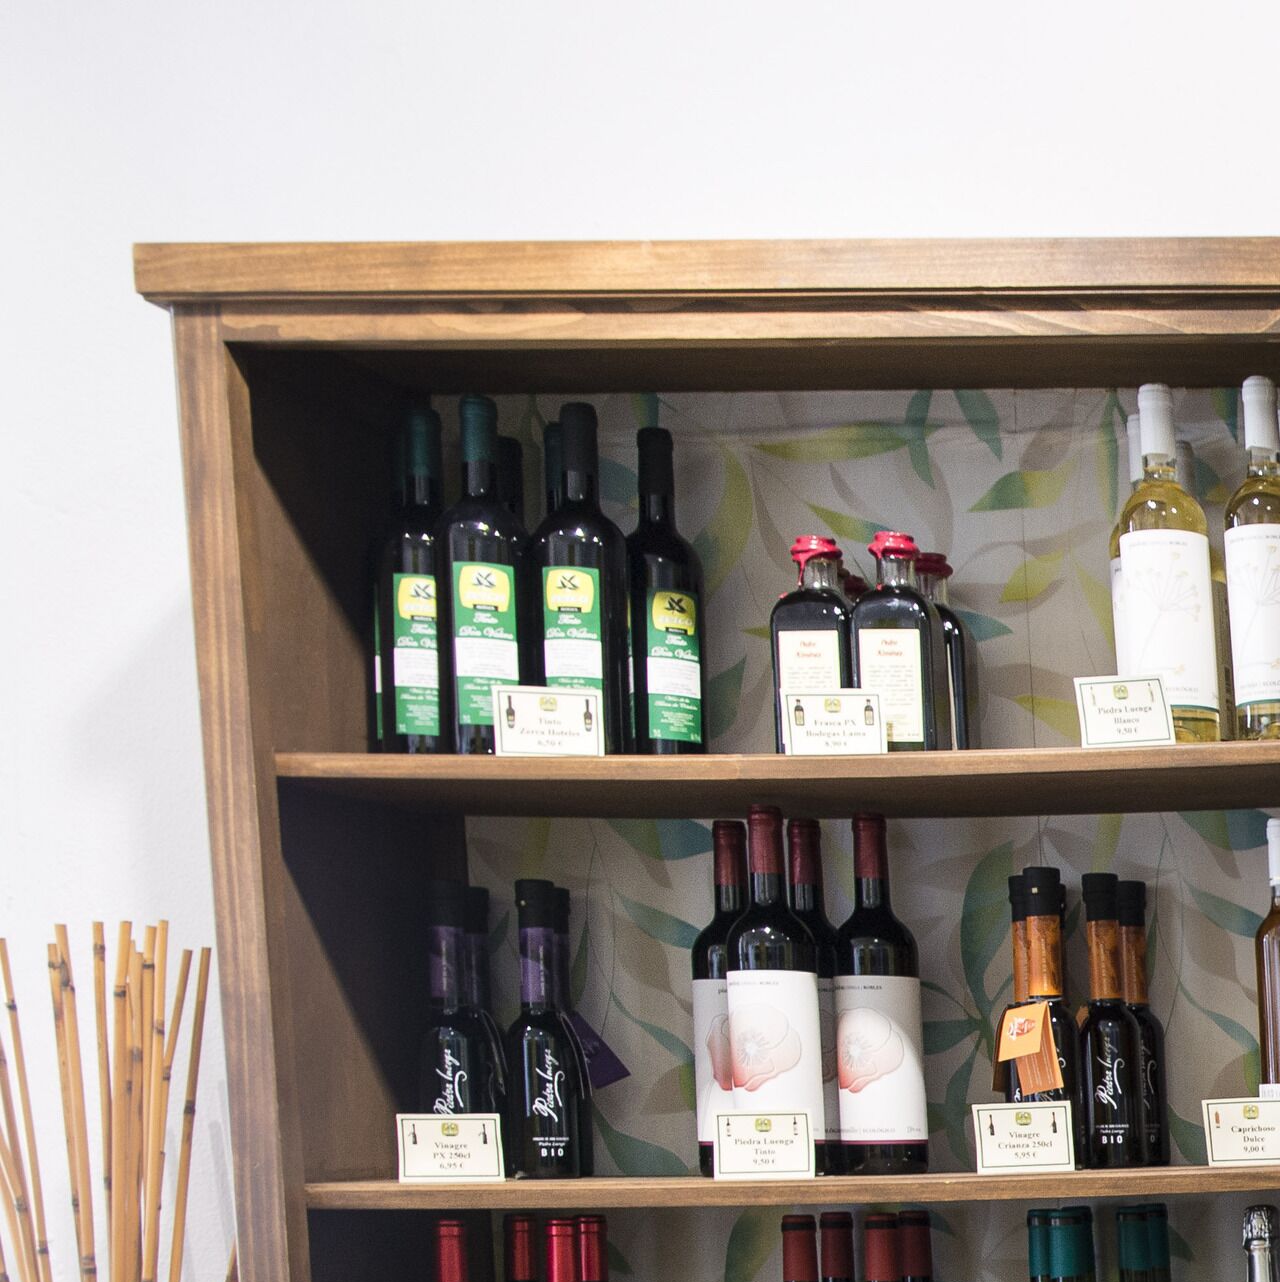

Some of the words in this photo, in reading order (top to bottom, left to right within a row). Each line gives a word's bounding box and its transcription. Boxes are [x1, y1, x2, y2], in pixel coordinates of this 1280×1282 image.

[1097, 706, 1122, 714] Piedra
[1124, 704, 1153, 714] Luenga
[1113, 716, 1140, 724] Blanco
[806, 730, 840, 738] Bodegas
[1230, 1124, 1276, 1135] Caprichoso
[1008, 1131, 1041, 1140] Vinagre
[1101, 1135, 1123, 1144] BIO
[1242, 1135, 1266, 1143] Dulce
[434, 1142, 468, 1151] Vinagre
[734, 1137, 763, 1146] Piedra
[765, 1137, 794, 1147] Luenga
[998, 1141, 1029, 1150] Crianza
[1031, 1140, 1053, 1149] 250cl
[540, 1148, 564, 1157] BIO
[1243, 1145, 1261, 1154] 9,00
[433, 1152, 446, 1160] PX
[448, 1151, 471, 1160] 250cl
[439, 1162, 458, 1171] 6,95
